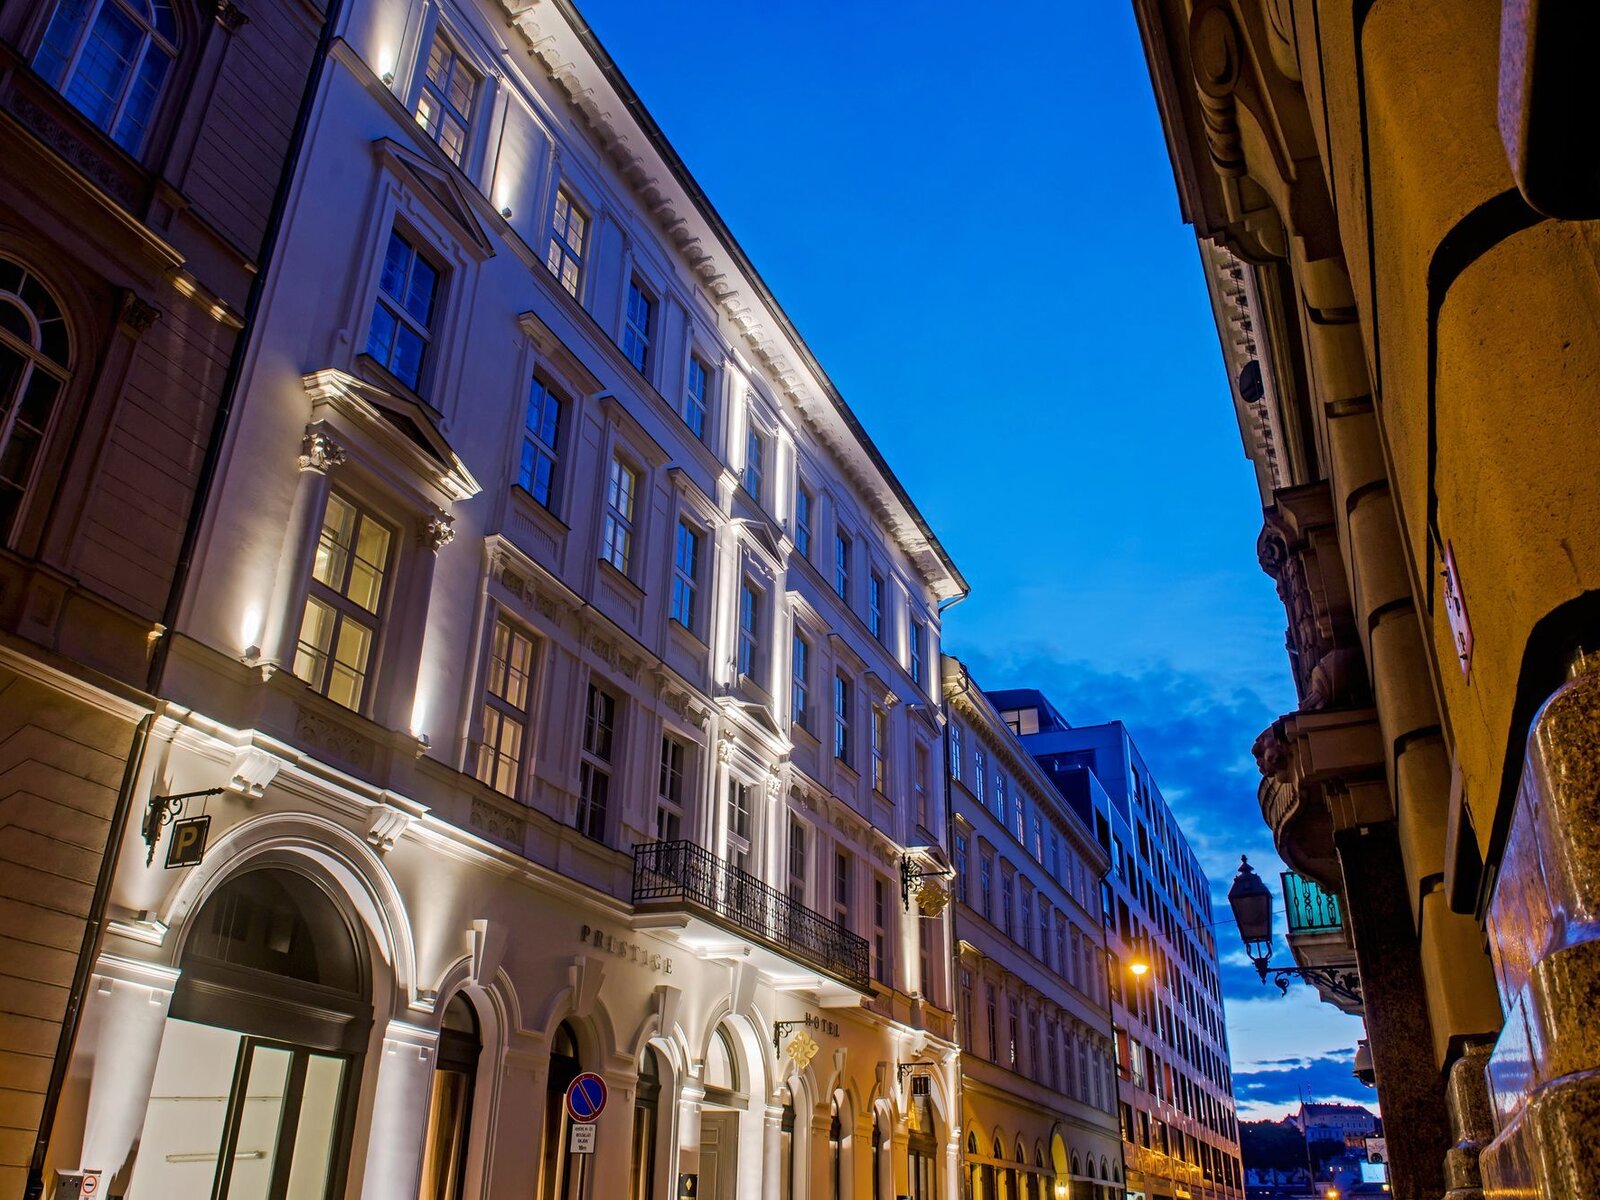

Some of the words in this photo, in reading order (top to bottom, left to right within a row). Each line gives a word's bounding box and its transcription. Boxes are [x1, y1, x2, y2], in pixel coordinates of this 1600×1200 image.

[175, 826, 198, 861] P
[580, 924, 673, 975] PRESTIGE
[805, 1011, 840, 1038] HOTEL
